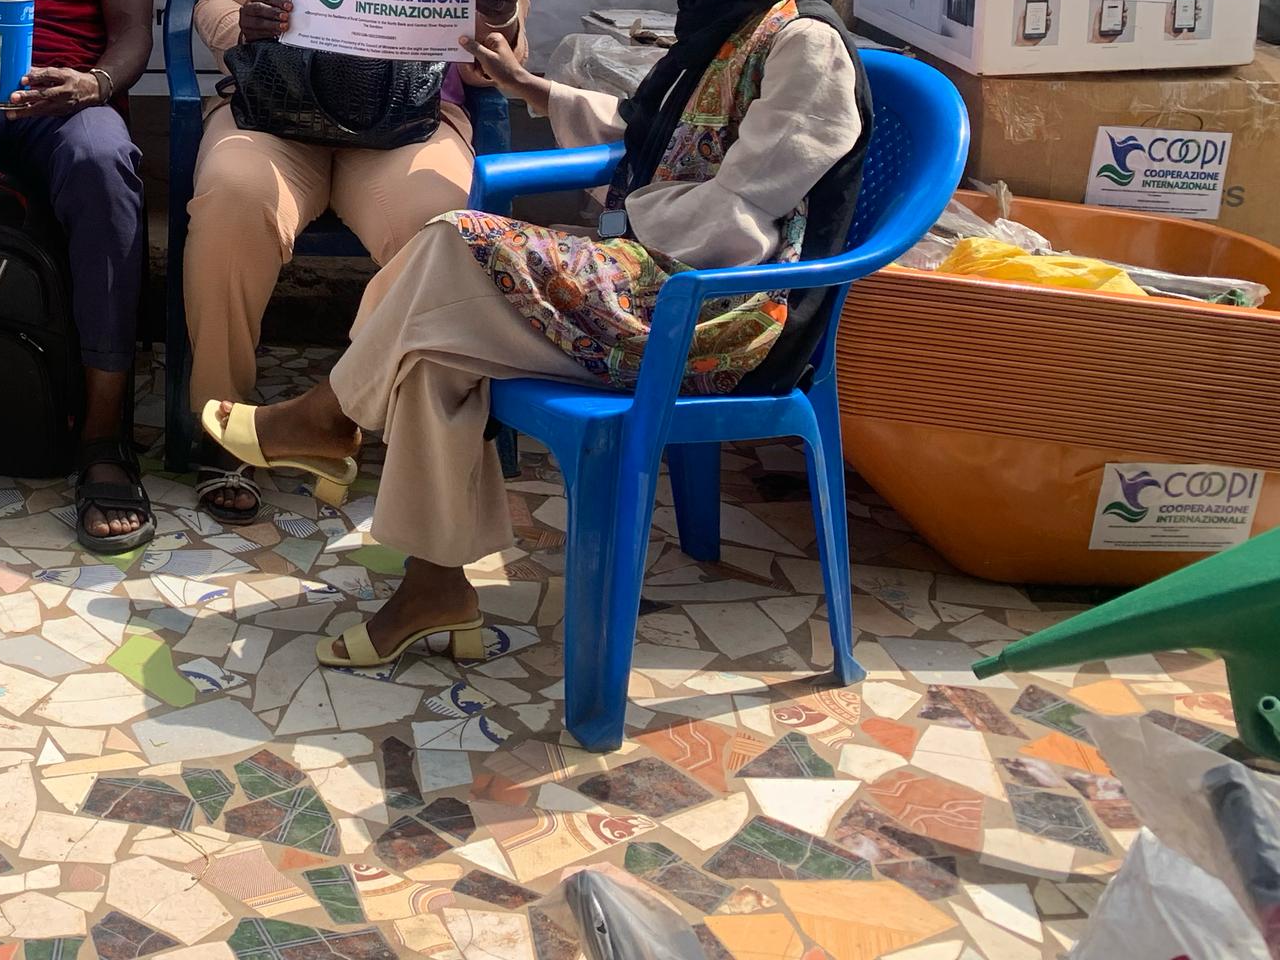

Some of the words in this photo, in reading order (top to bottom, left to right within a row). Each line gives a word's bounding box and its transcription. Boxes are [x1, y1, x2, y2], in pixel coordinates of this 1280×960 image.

[355, 1, 469, 20] INTERNAZIONALE
[1147, 137, 1227, 170] COOPI
[1144, 168, 1219, 181] COOPERAZIONE
[1142, 179, 1217, 191] INTERNAZIONALE
[1164, 471, 1258, 503] COOPI
[1159, 504, 1250, 514] COOPERAZIONE
[1156, 515, 1247, 524] INTERNAZIONALE
